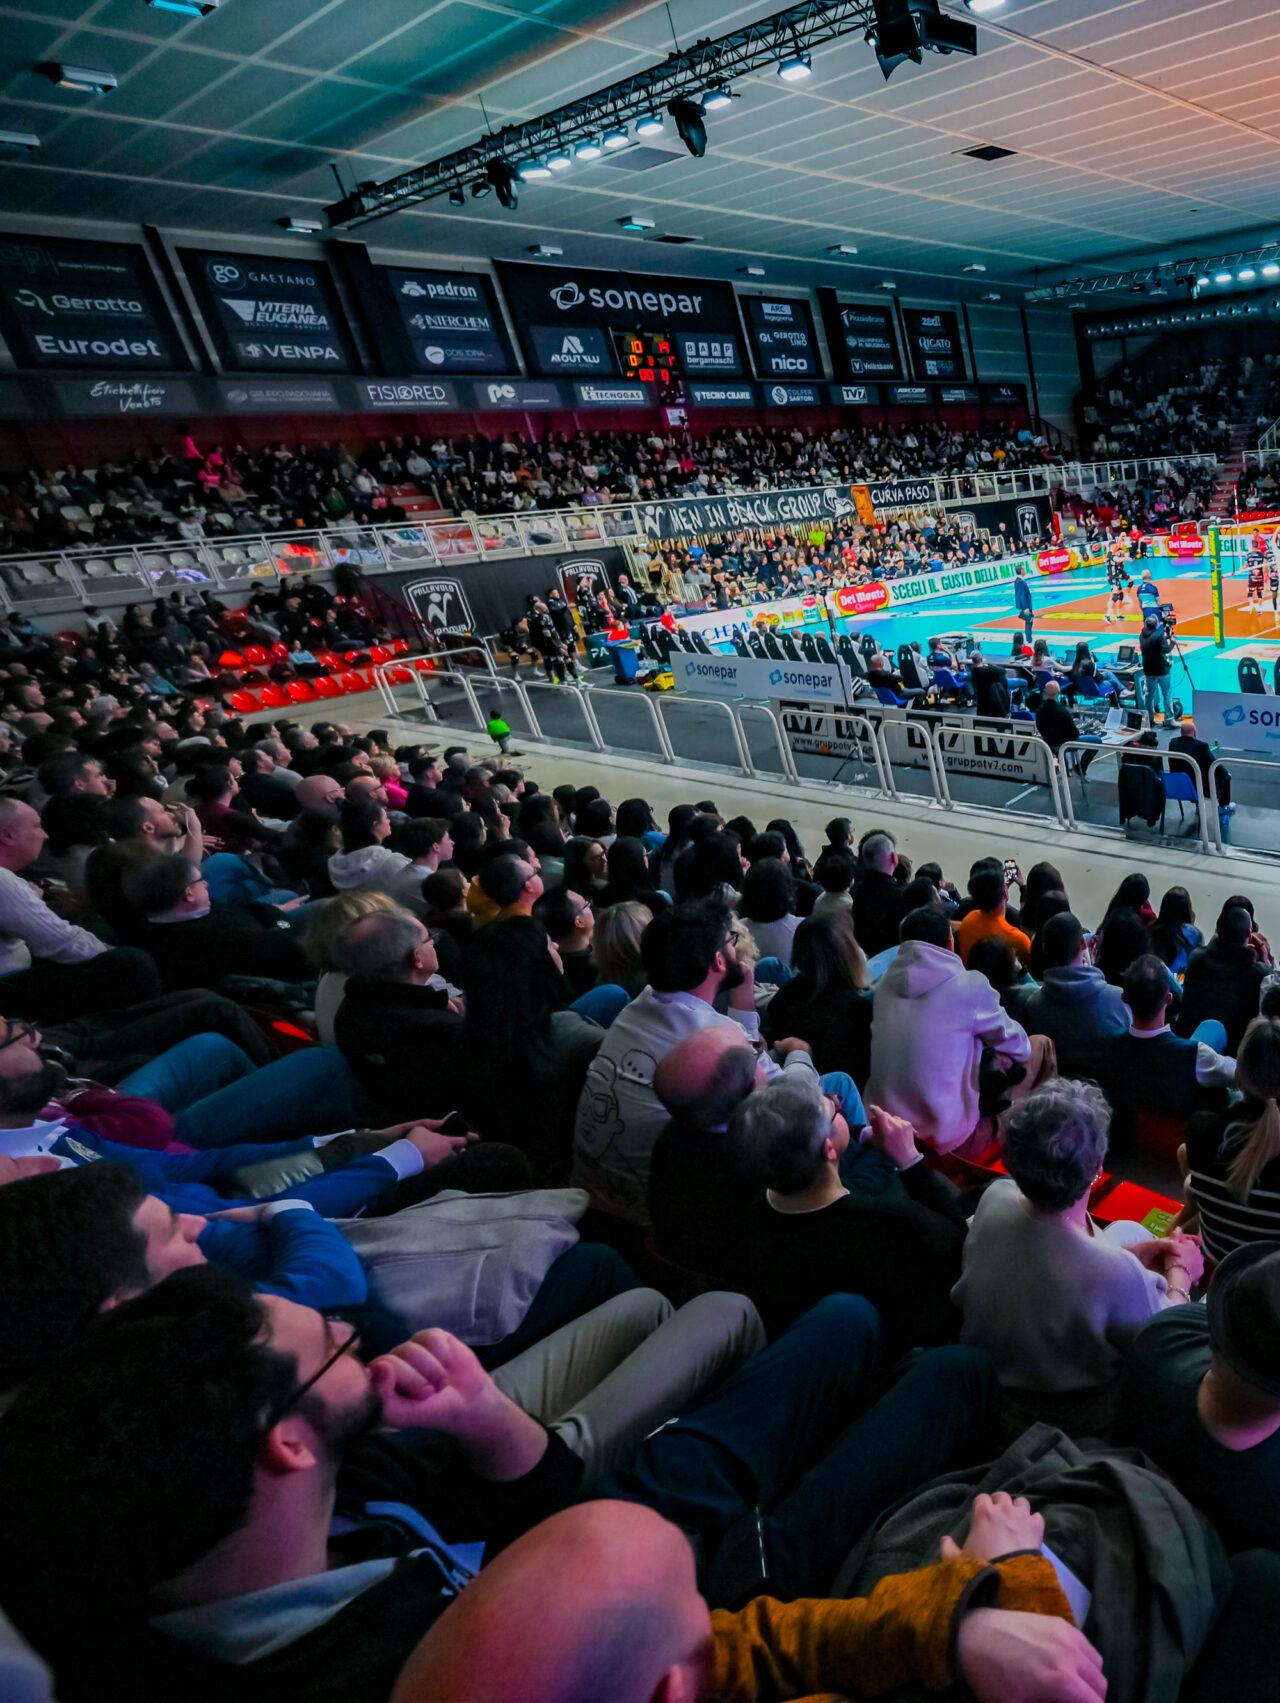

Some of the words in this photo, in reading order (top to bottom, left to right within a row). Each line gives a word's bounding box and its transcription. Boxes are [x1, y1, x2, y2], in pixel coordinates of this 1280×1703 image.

[248, 271, 315, 287] GAETANO
[427, 281, 478, 299] pedron
[51, 294, 143, 312] Gerotto
[258, 302, 315, 315] VITERIA
[588, 287, 702, 317] sonepar
[256, 312, 328, 326] EUGANEA
[425, 315, 490, 328] INTERCHEM
[34, 334, 161, 356] Eurodet
[263, 345, 340, 360] VENPA
[771, 354, 808, 370] nico
[871, 485, 905, 504] CURVA
[905, 485, 930, 501] PASO
[669, 504, 704, 535] MEN
[704, 503, 727, 528] IN
[727, 496, 777, 527] BLACK
[777, 492, 822, 519] GROUP
[1051, 552, 1071, 566] Monte
[565, 566, 600, 577] PALLAVOLO
[413, 584, 455, 597] PALLAVOLO
[891, 584, 928, 602] SCEGLI
[929, 579, 940, 594] IL
[942, 572, 973, 591] GUSTO
[974, 565, 999, 585] DELLA
[840, 592, 857, 606] Del
[857, 588, 887, 604] Monte
[697, 664, 737, 680] sonepar
[783, 671, 833, 688] sonepar
[974, 723, 1033, 757] TV7
